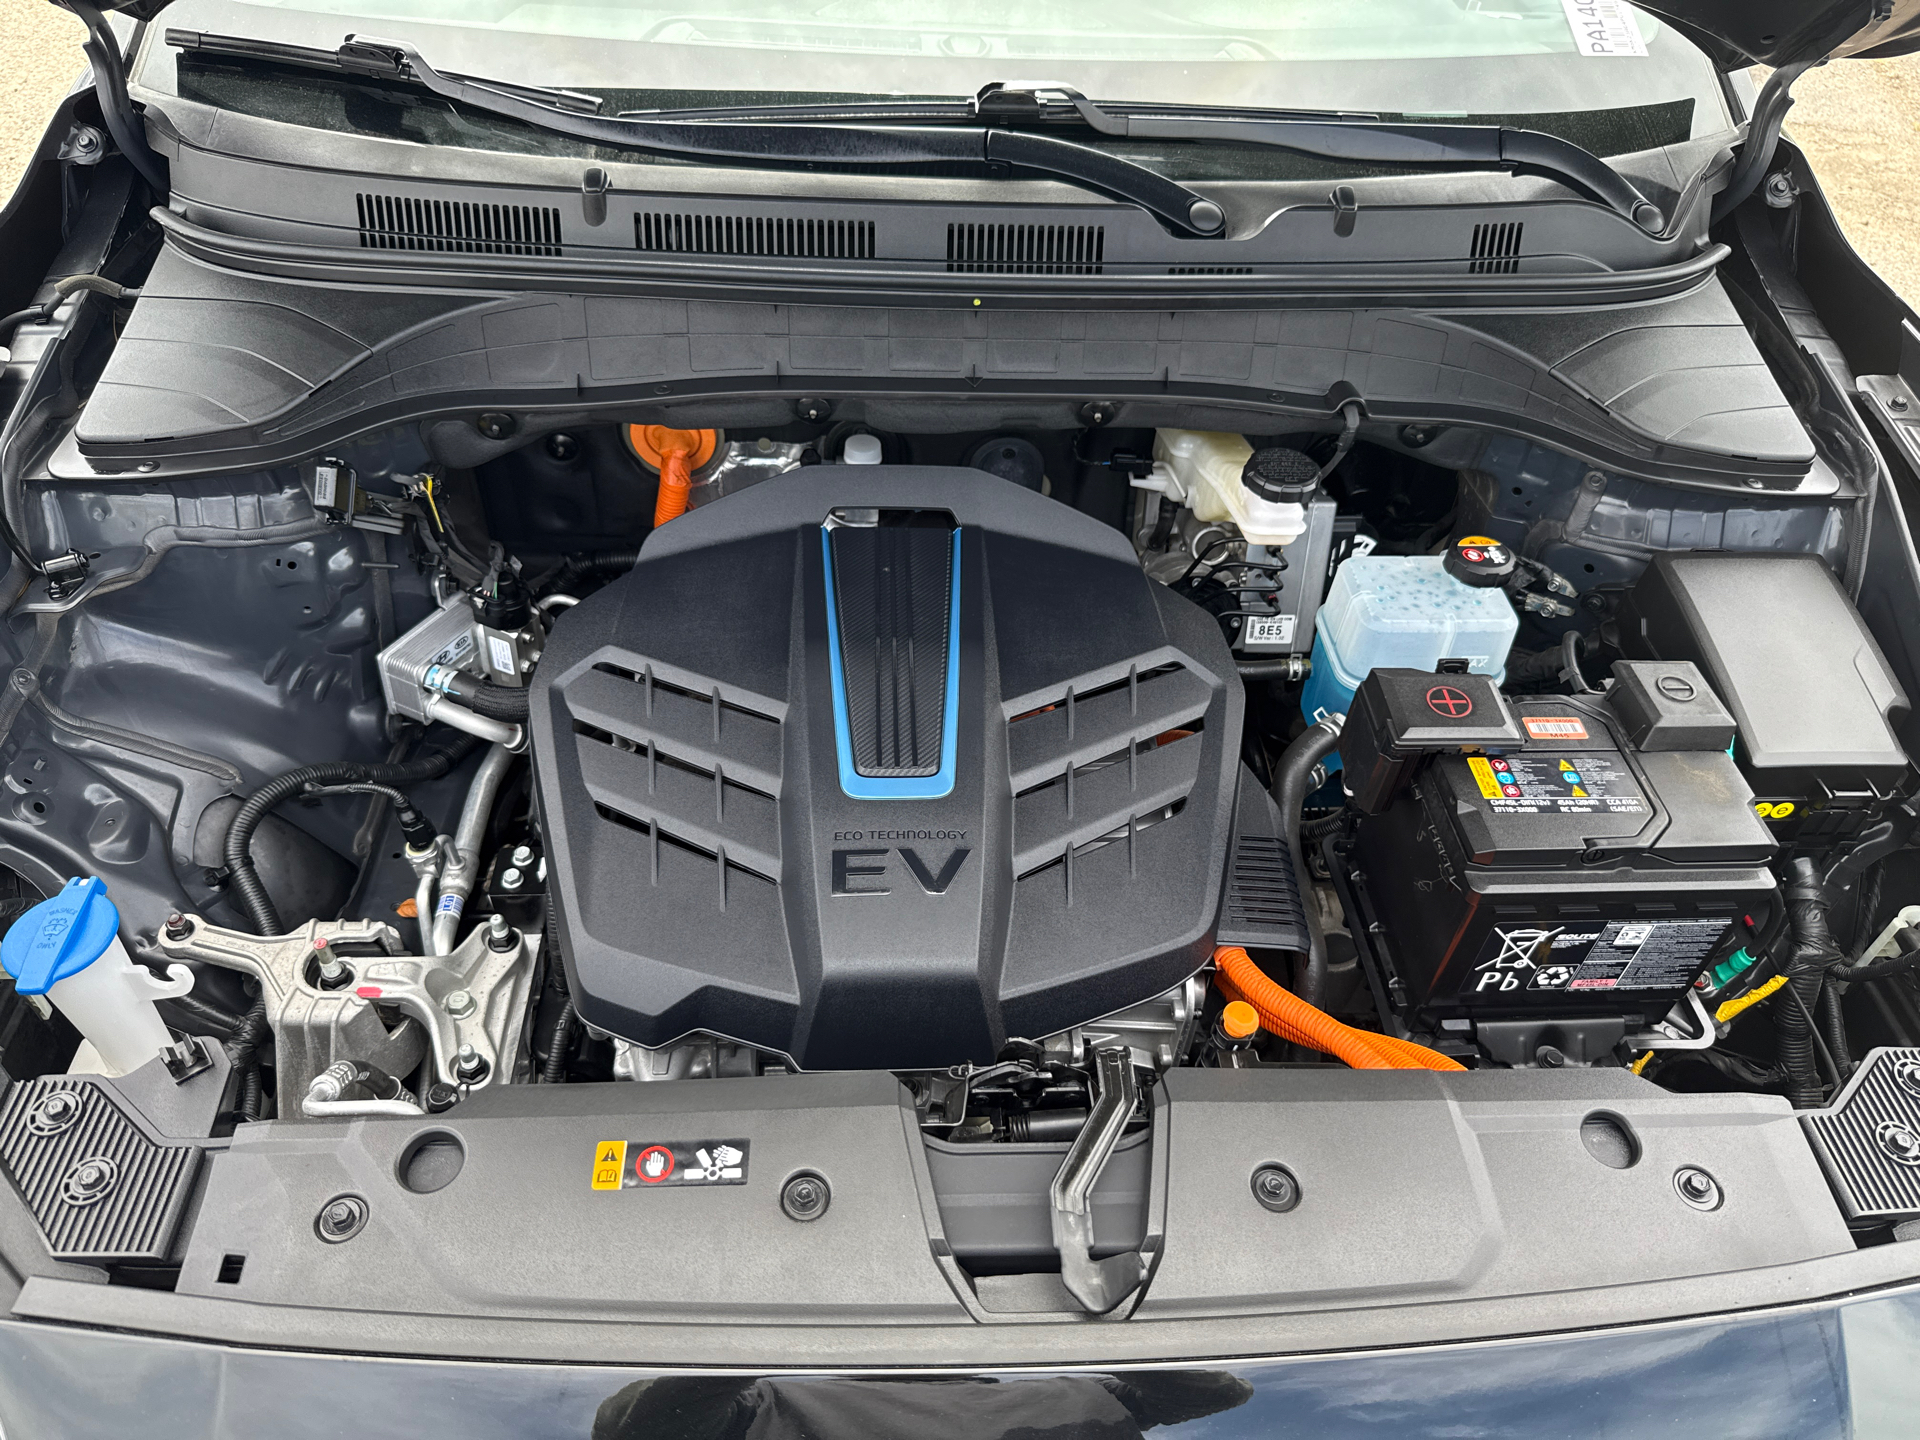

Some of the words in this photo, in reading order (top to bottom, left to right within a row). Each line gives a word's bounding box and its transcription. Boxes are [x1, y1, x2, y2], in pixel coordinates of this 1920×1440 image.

[1258, 625, 1283, 636] 8E5
[1468, 658, 1489, 668] AX
[834, 830, 863, 841] ECO
[868, 830, 967, 840] TECHNOLOGY
[831, 848, 972, 897] EV
[48, 907, 79, 917] WASHER
[36, 941, 57, 950] ONLY
[1475, 971, 1519, 992] Pb
